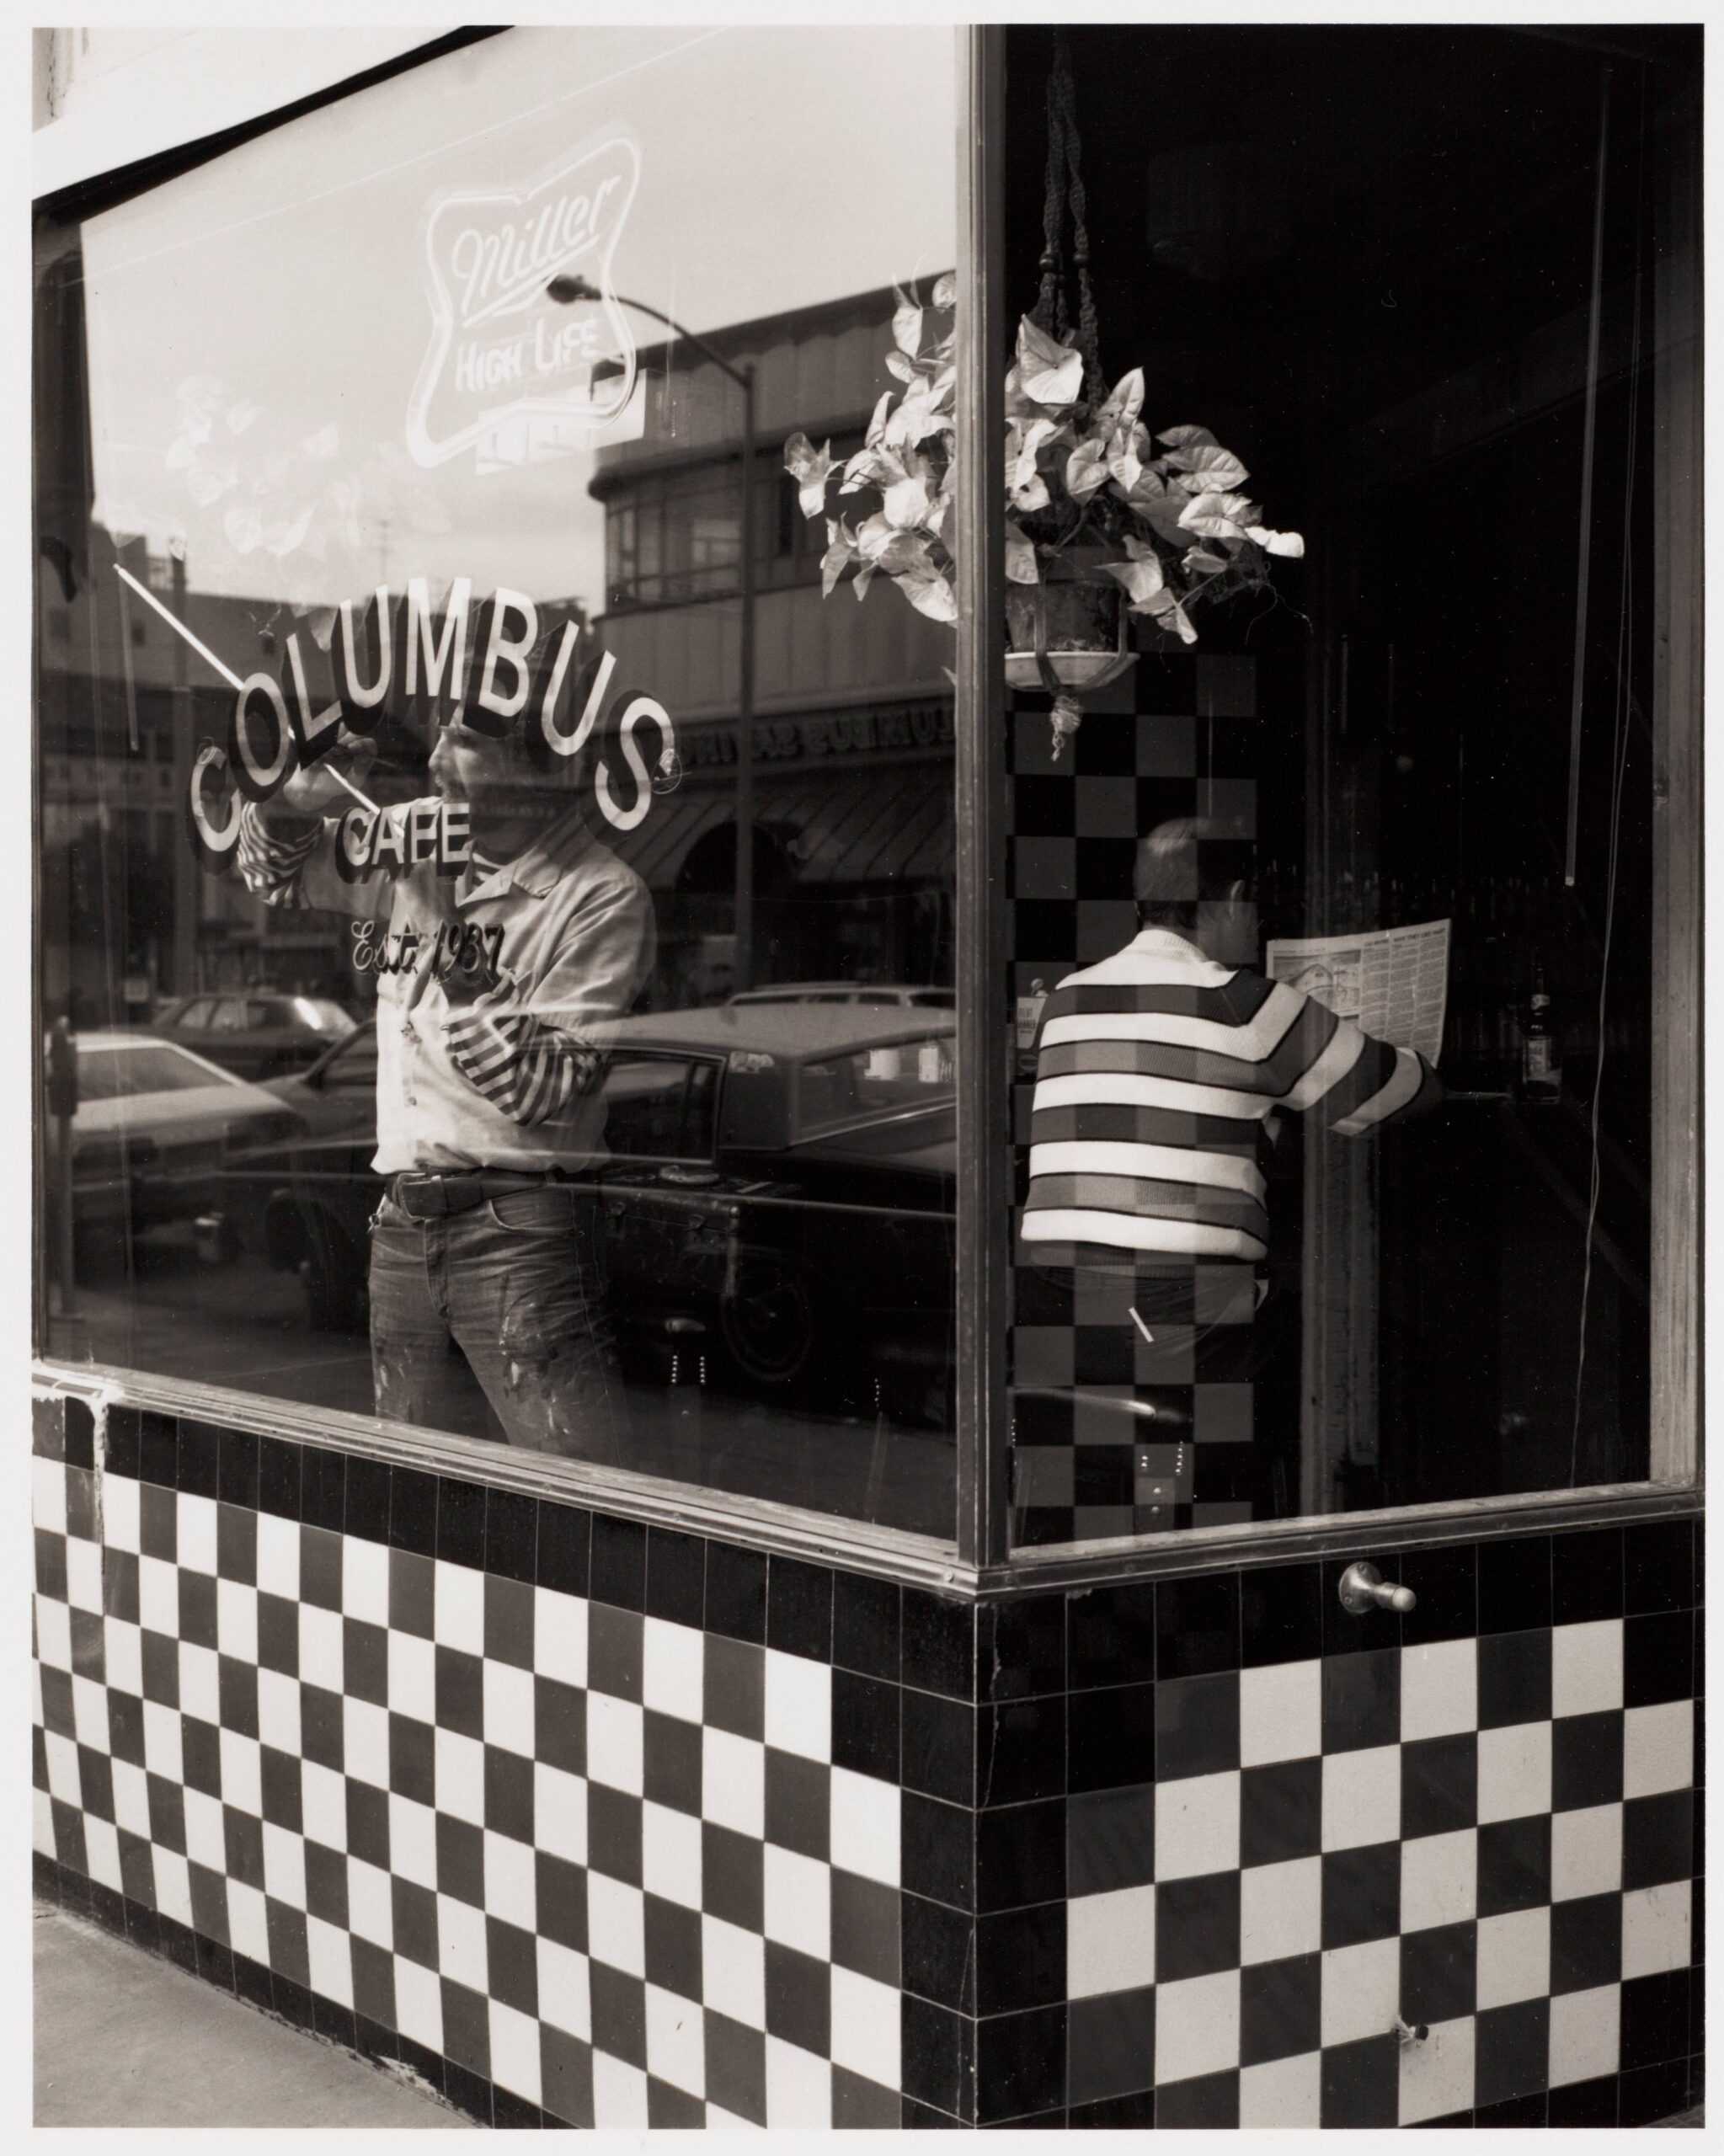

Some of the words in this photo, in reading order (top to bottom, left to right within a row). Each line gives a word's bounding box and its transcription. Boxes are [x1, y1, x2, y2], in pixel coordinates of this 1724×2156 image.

[451, 175, 622, 316] Miller
[187, 577, 675, 856] COLUMBUS
[339, 803, 471, 876] CAFE
[430, 919, 505, 979] 1937
